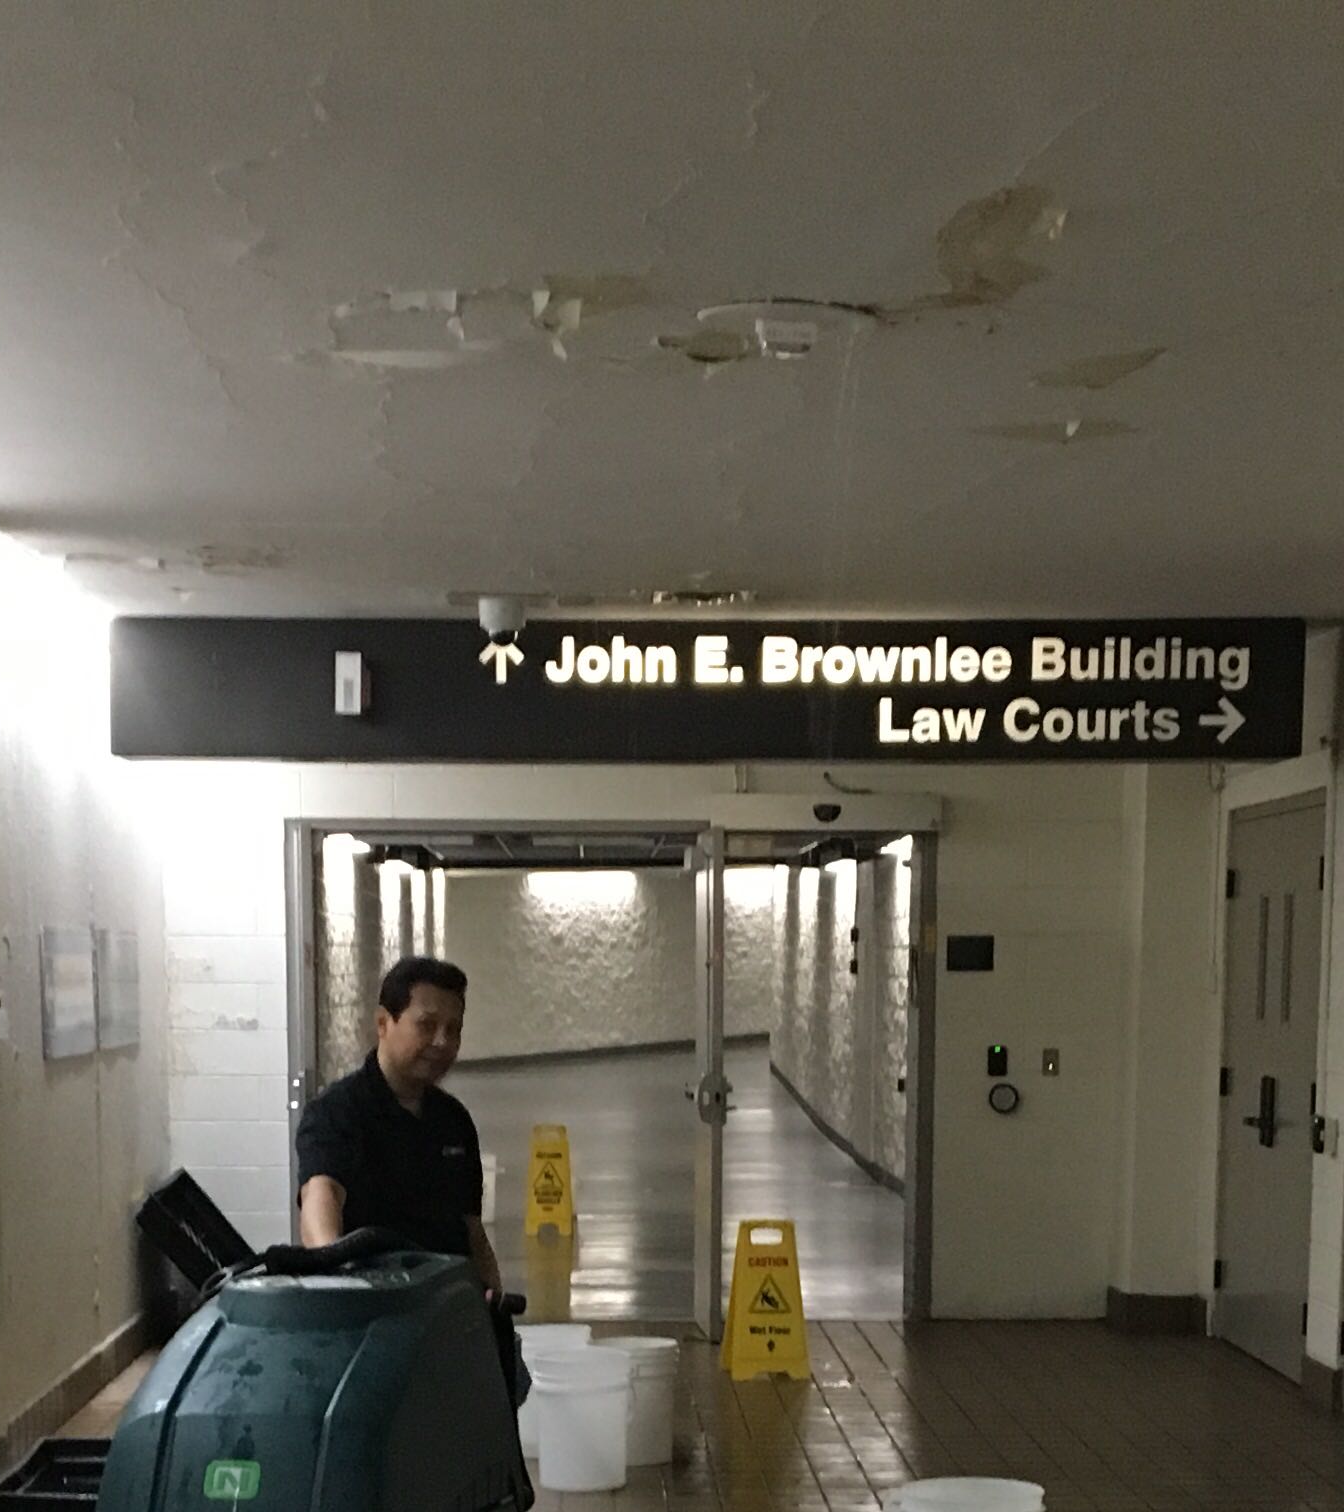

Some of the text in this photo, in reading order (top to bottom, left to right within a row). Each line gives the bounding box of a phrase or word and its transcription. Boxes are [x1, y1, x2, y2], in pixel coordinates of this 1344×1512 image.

[545, 635, 1251, 691] John E. Brownlee Building
[878, 697, 1181, 744] Law Courts
[748, 1256, 789, 1268] CAUTION
